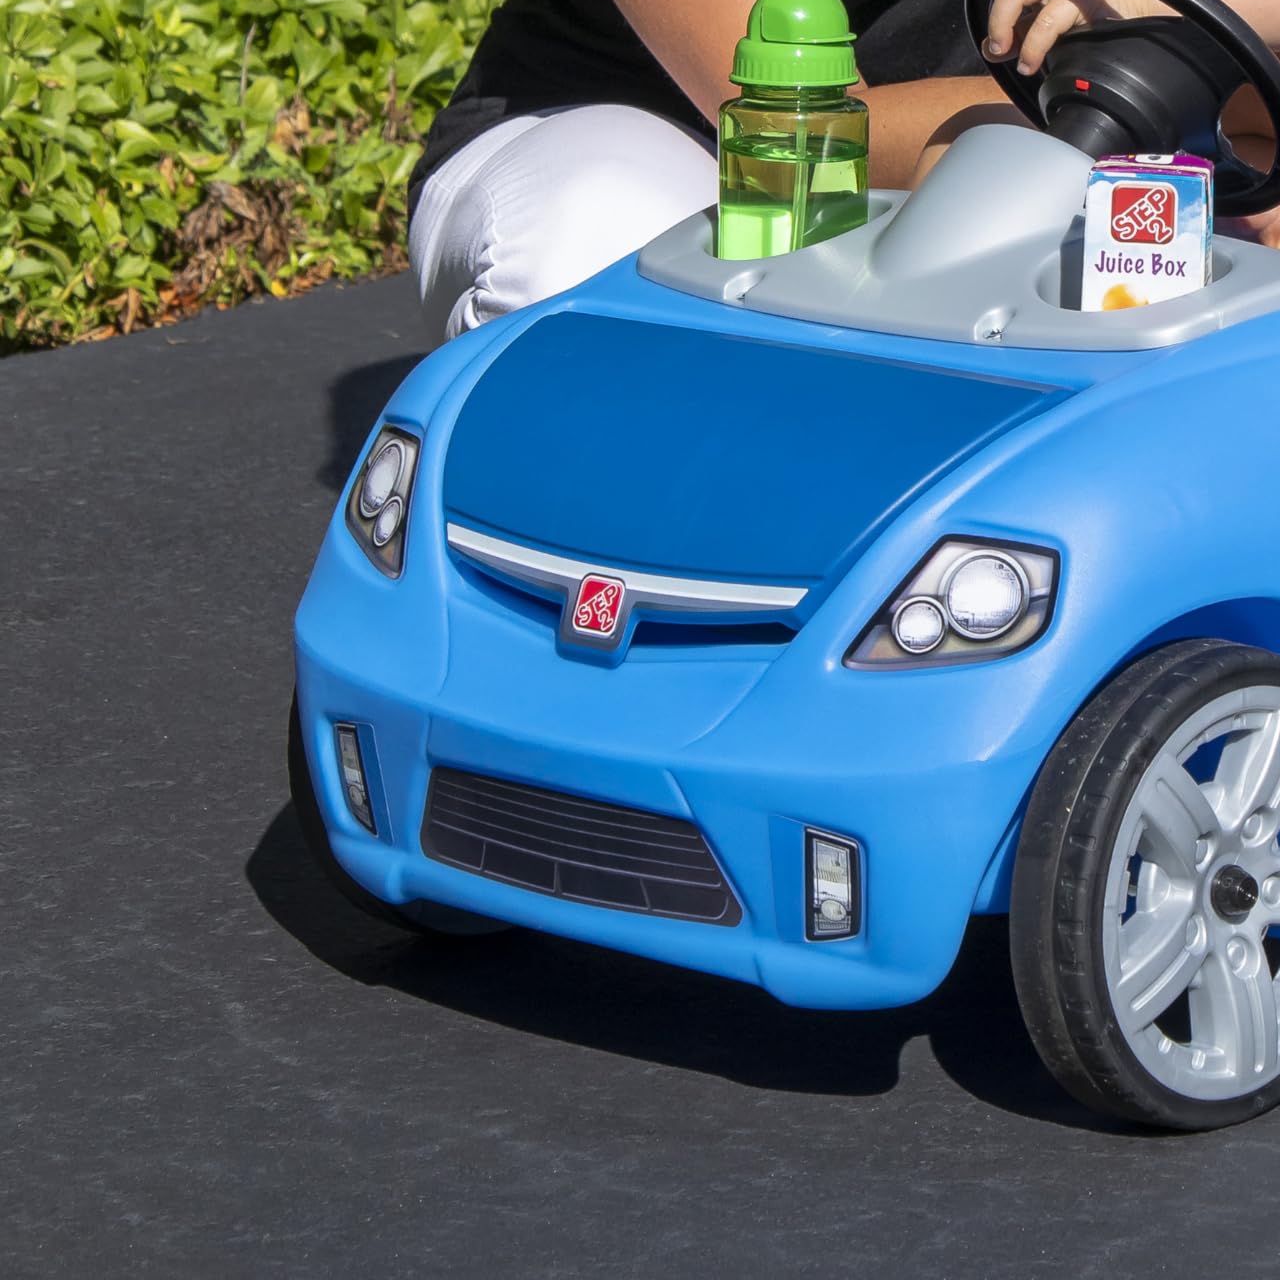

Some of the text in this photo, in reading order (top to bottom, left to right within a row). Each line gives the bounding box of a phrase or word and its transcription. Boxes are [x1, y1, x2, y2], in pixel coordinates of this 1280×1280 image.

[1112, 187, 1168, 240] STEP
[1147, 217, 1173, 243] 2
[1095, 251, 1187, 277] Juice Box
[578, 583, 618, 626] STEP
[598, 609, 614, 631] 2
